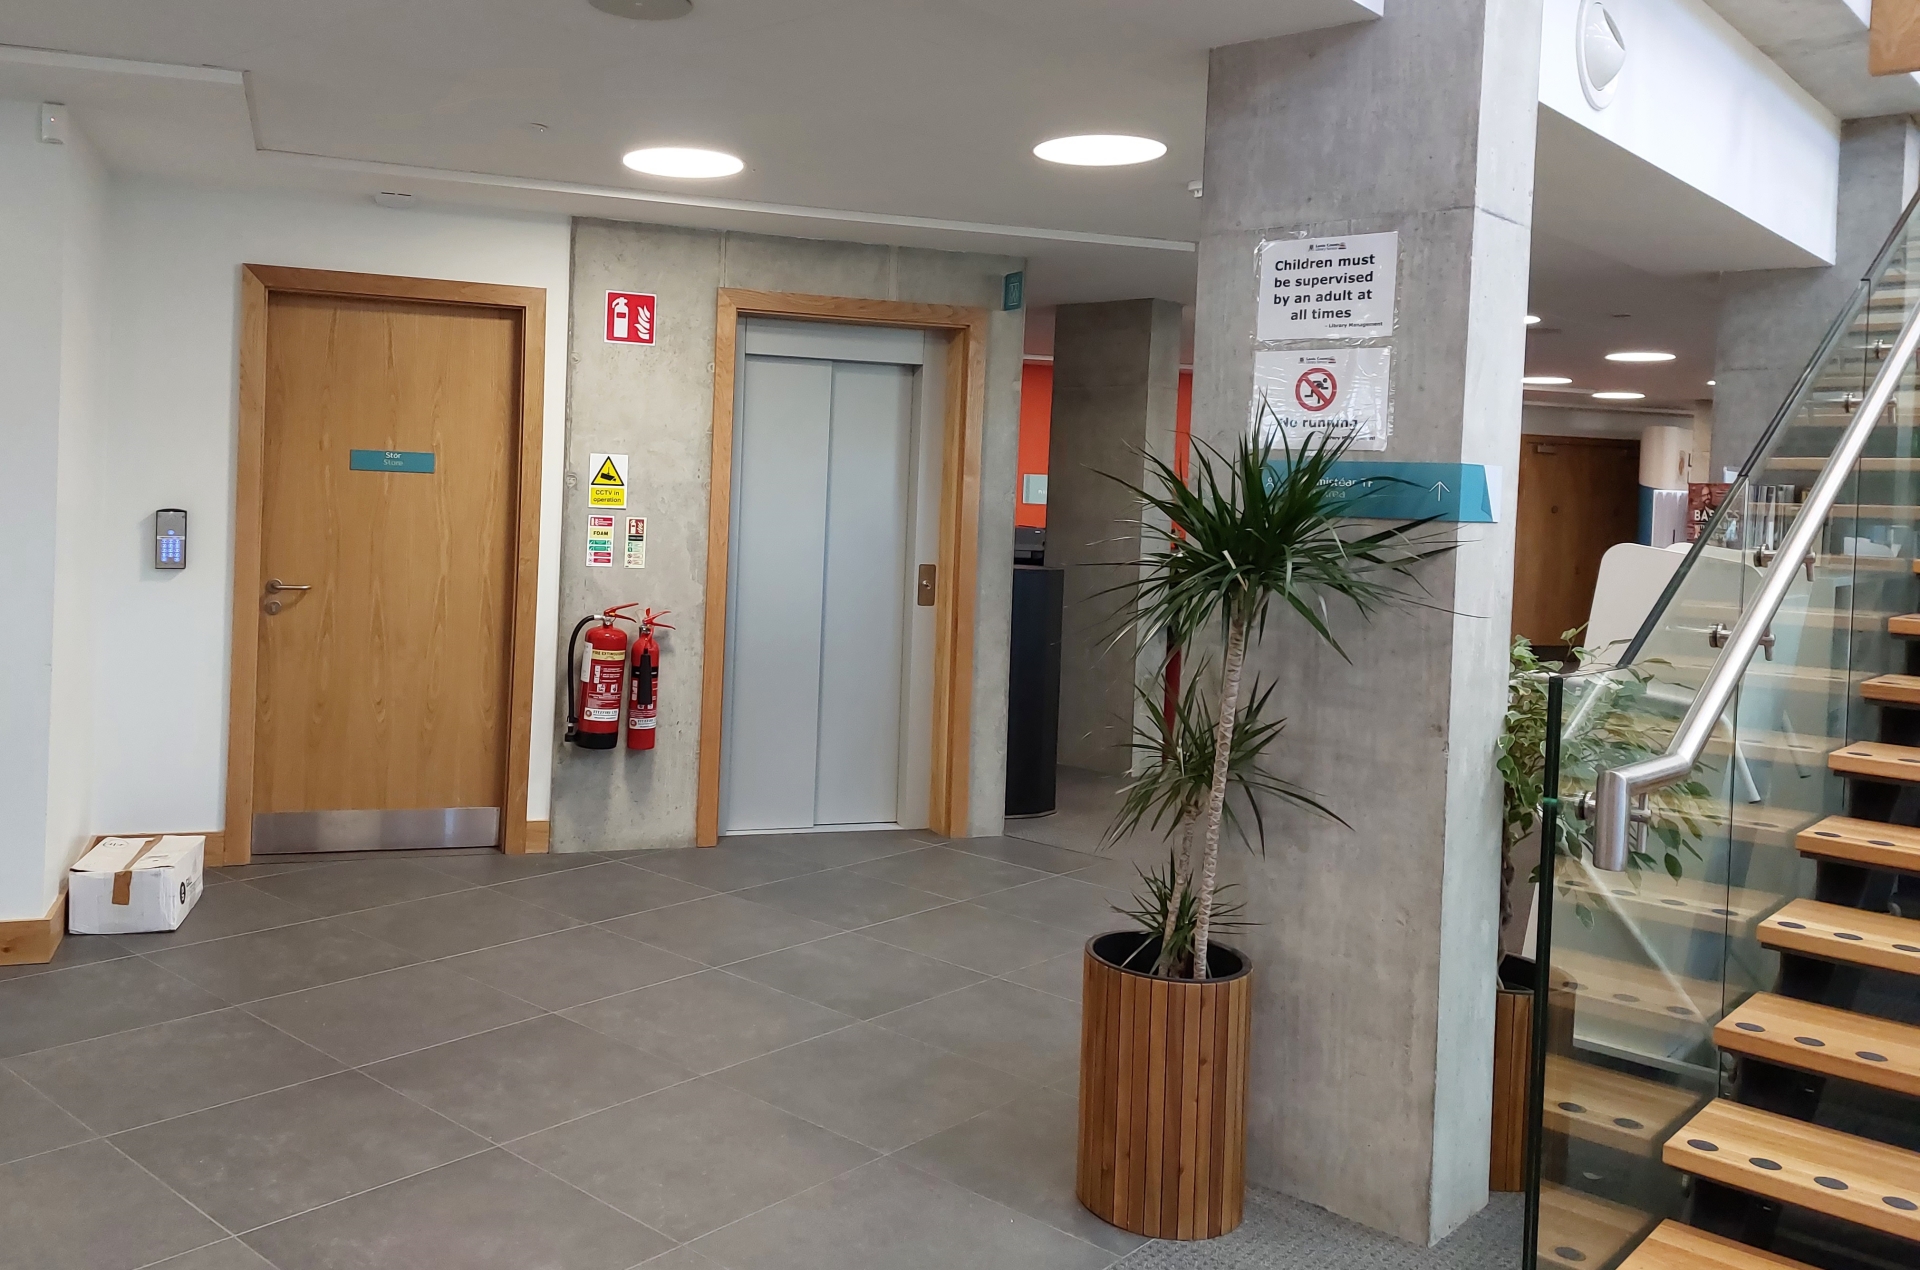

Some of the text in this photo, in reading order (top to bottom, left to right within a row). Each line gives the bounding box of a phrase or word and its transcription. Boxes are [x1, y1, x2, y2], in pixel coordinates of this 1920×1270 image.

[1275, 254, 1376, 271] Children must
[1274, 271, 1374, 288] be supervised
[1273, 289, 1373, 307] by an adult at
[1290, 306, 1352, 320] all times
[1349, 321, 1383, 329] Management
[593, 496, 622, 504] operation
